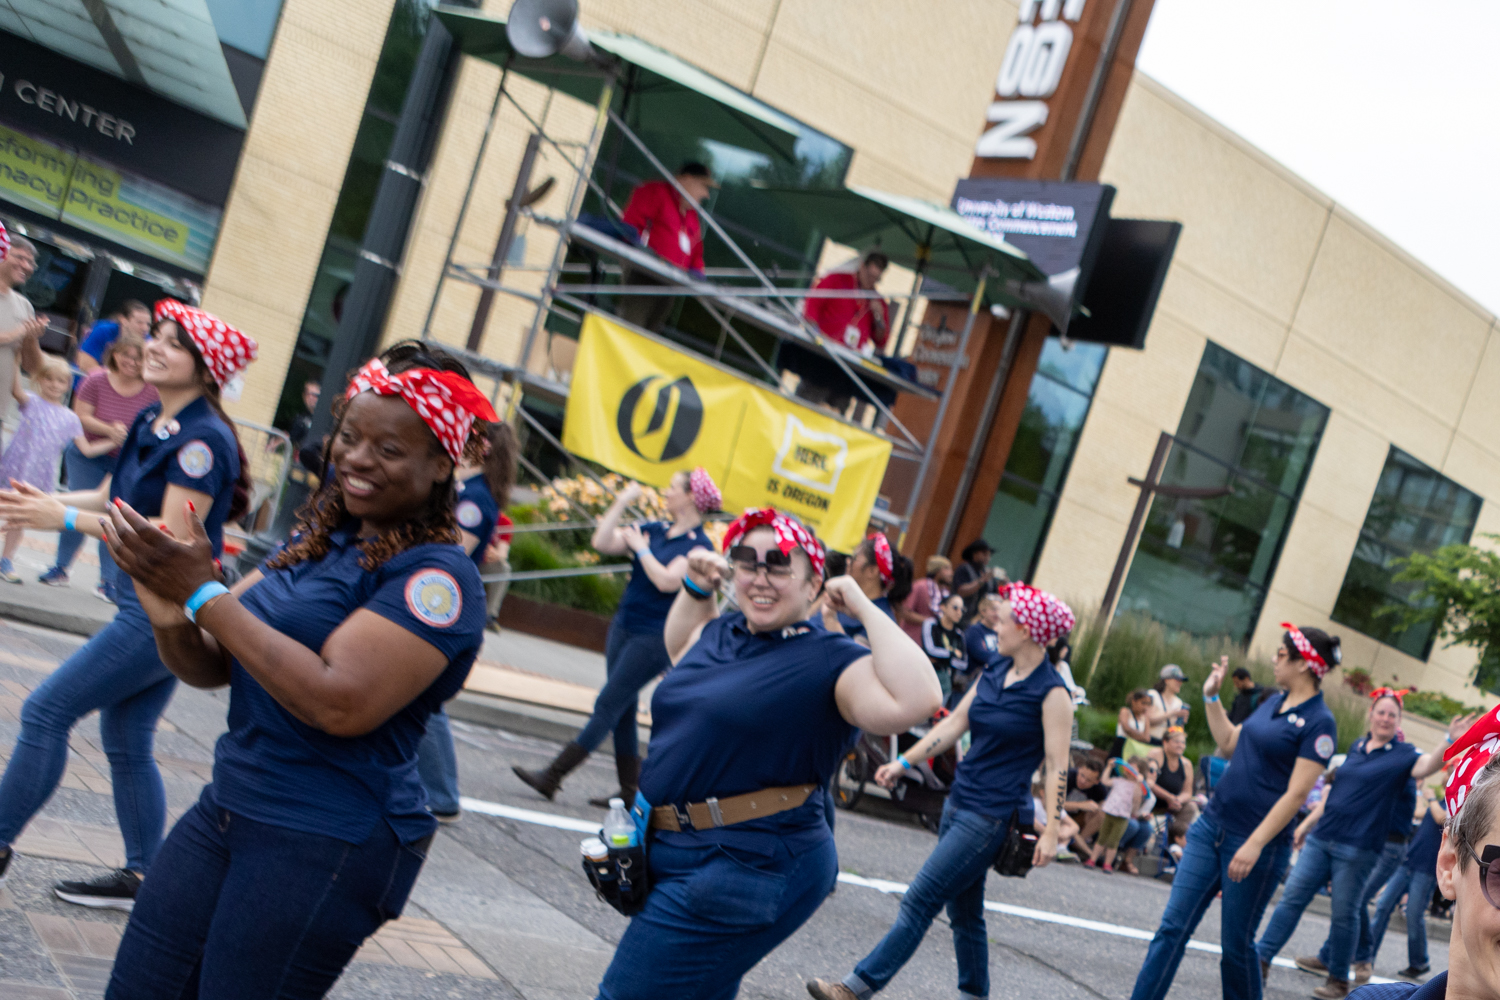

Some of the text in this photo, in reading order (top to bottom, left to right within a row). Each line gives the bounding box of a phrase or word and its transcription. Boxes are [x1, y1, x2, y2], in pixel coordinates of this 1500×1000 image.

[14, 79, 136, 146] CENTER
[69, 189, 180, 244] practice
[766, 478, 831, 512] IS OREGON
